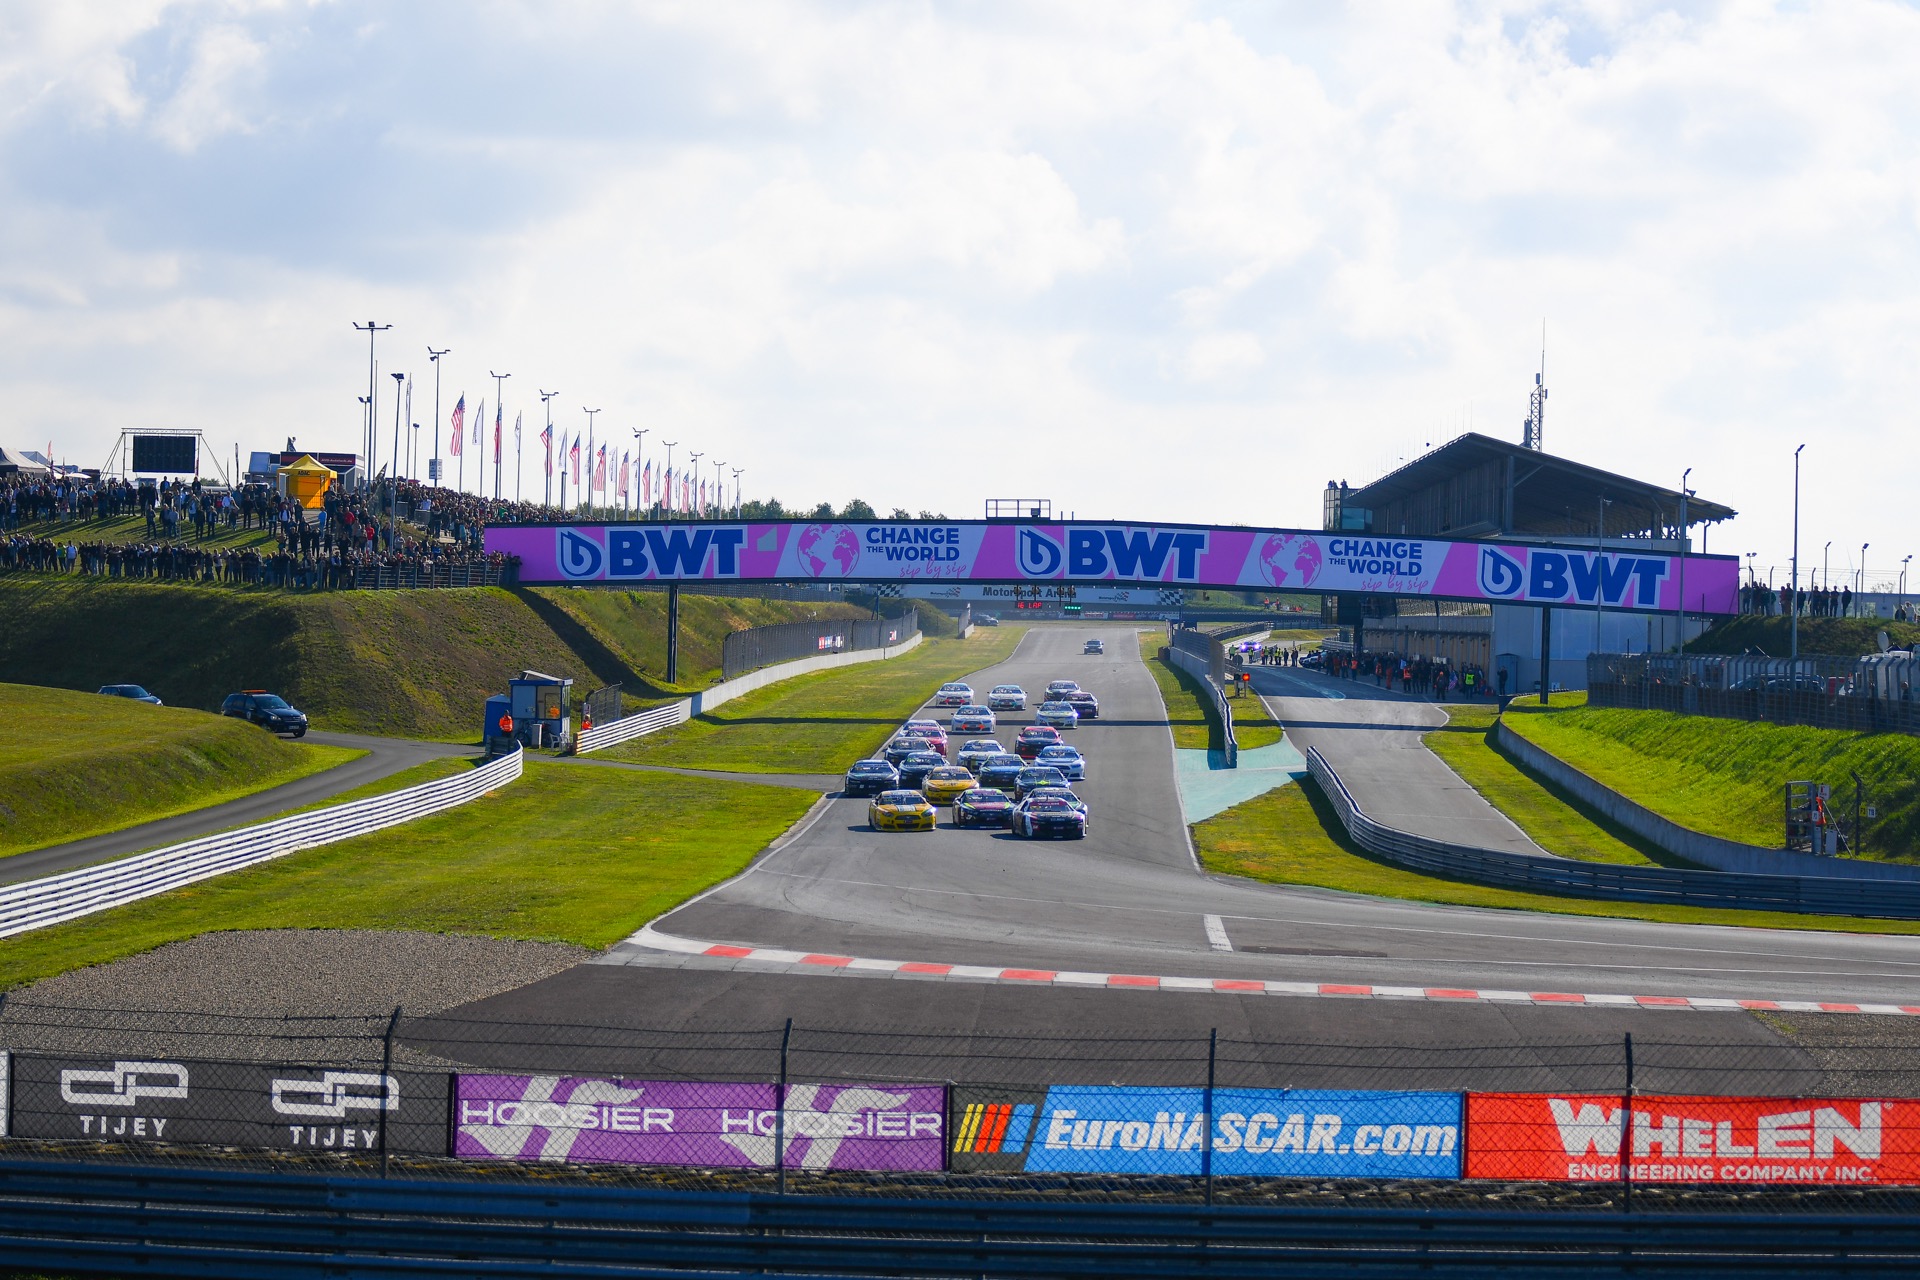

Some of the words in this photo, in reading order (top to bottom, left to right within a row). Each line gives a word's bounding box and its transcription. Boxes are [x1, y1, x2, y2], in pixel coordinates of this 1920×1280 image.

[866, 527, 960, 544] CHANGE
[609, 529, 743, 576] BWT
[885, 546, 960, 561] WORLD
[1069, 529, 1205, 579] BWT
[1329, 539, 1422, 559] CHANGE
[900, 564, 920, 578] sip
[926, 554, 941, 578] by
[946, 562, 967, 578] sip
[1329, 557, 1346, 566] THE
[1347, 558, 1422, 576] WORLD
[1529, 551, 1666, 605] BWT
[982, 587, 1042, 599] Motorpot
[1361, 578, 1382, 592] sip
[1388, 569, 1403, 593] by
[1407, 577, 1429, 594] sip
[80, 1115, 167, 1137] TIJEY
[461, 1100, 675, 1132] HOOSIER
[722, 1109, 942, 1138] HOOSIER
[290, 1126, 377, 1149] TIJEY
[1045, 1109, 1458, 1157] EuroNASCAR.com
[1548, 1098, 1882, 1160] WHELEN
[1567, 1163, 1718, 1180] ENGINEERING
[1720, 1165, 1829, 1181] COMPANY
[1835, 1166, 1878, 1182] INC.
